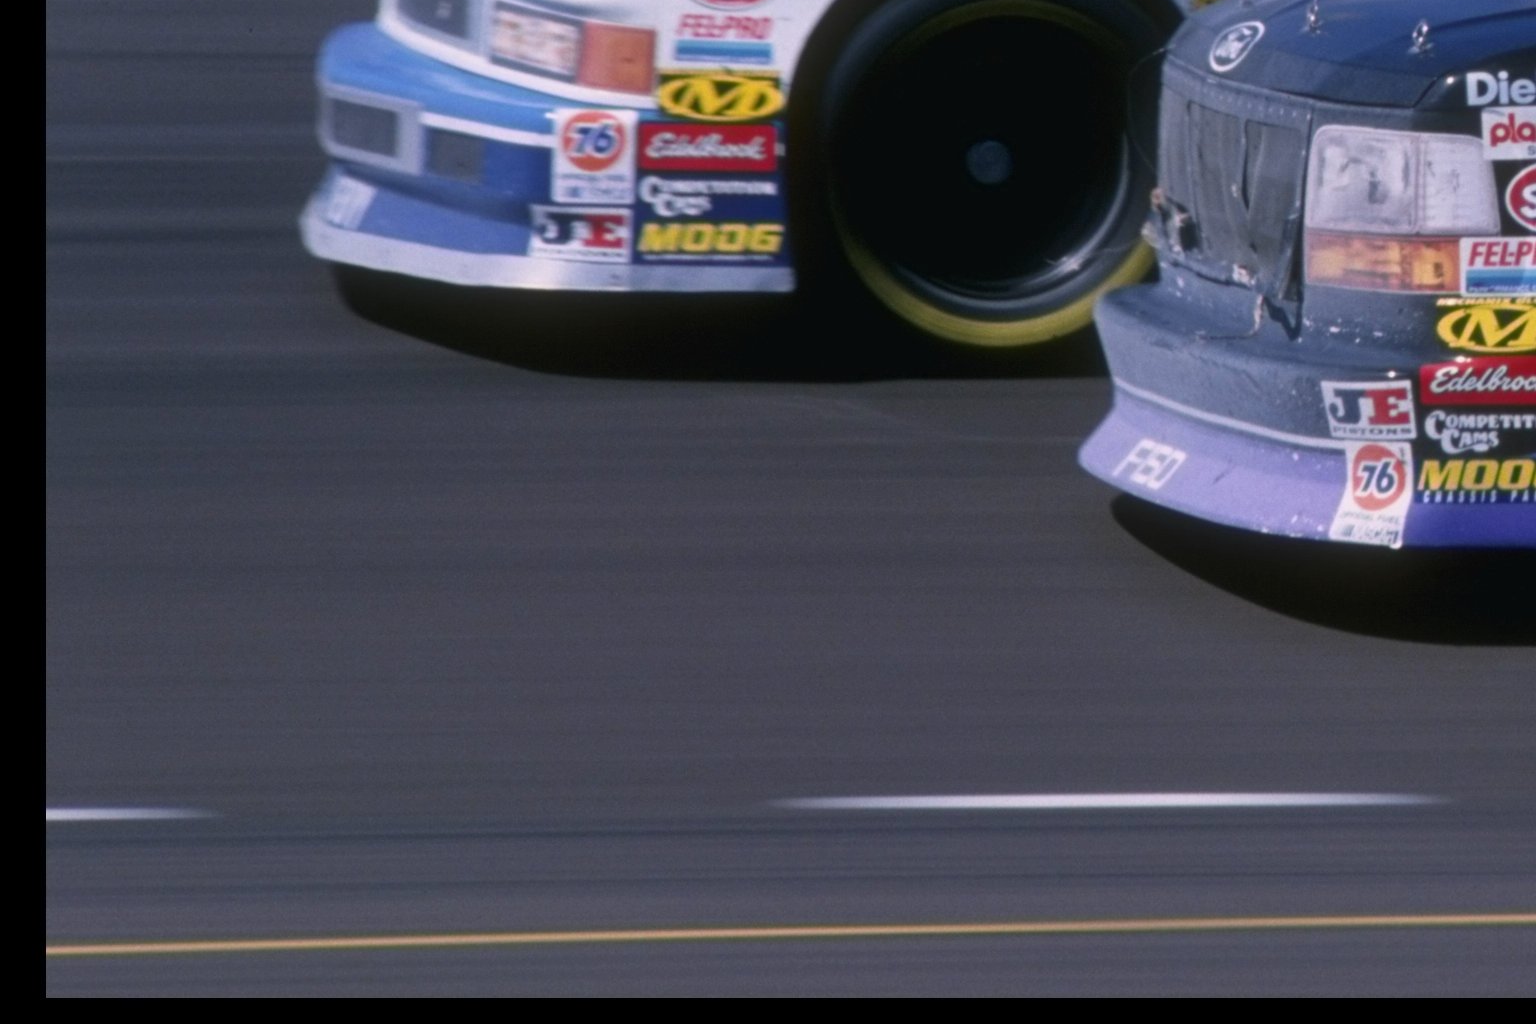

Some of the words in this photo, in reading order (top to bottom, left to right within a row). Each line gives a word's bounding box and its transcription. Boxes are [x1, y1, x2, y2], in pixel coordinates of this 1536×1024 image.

[564, 122, 617, 158] 76
[535, 214, 626, 248] JE
[637, 222, 786, 253] MOOG
[1327, 387, 1411, 425] JE
[1332, 426, 1413, 437] PISTONS
[1357, 457, 1399, 497] 76
[1423, 489, 1498, 504] CHASSIS
